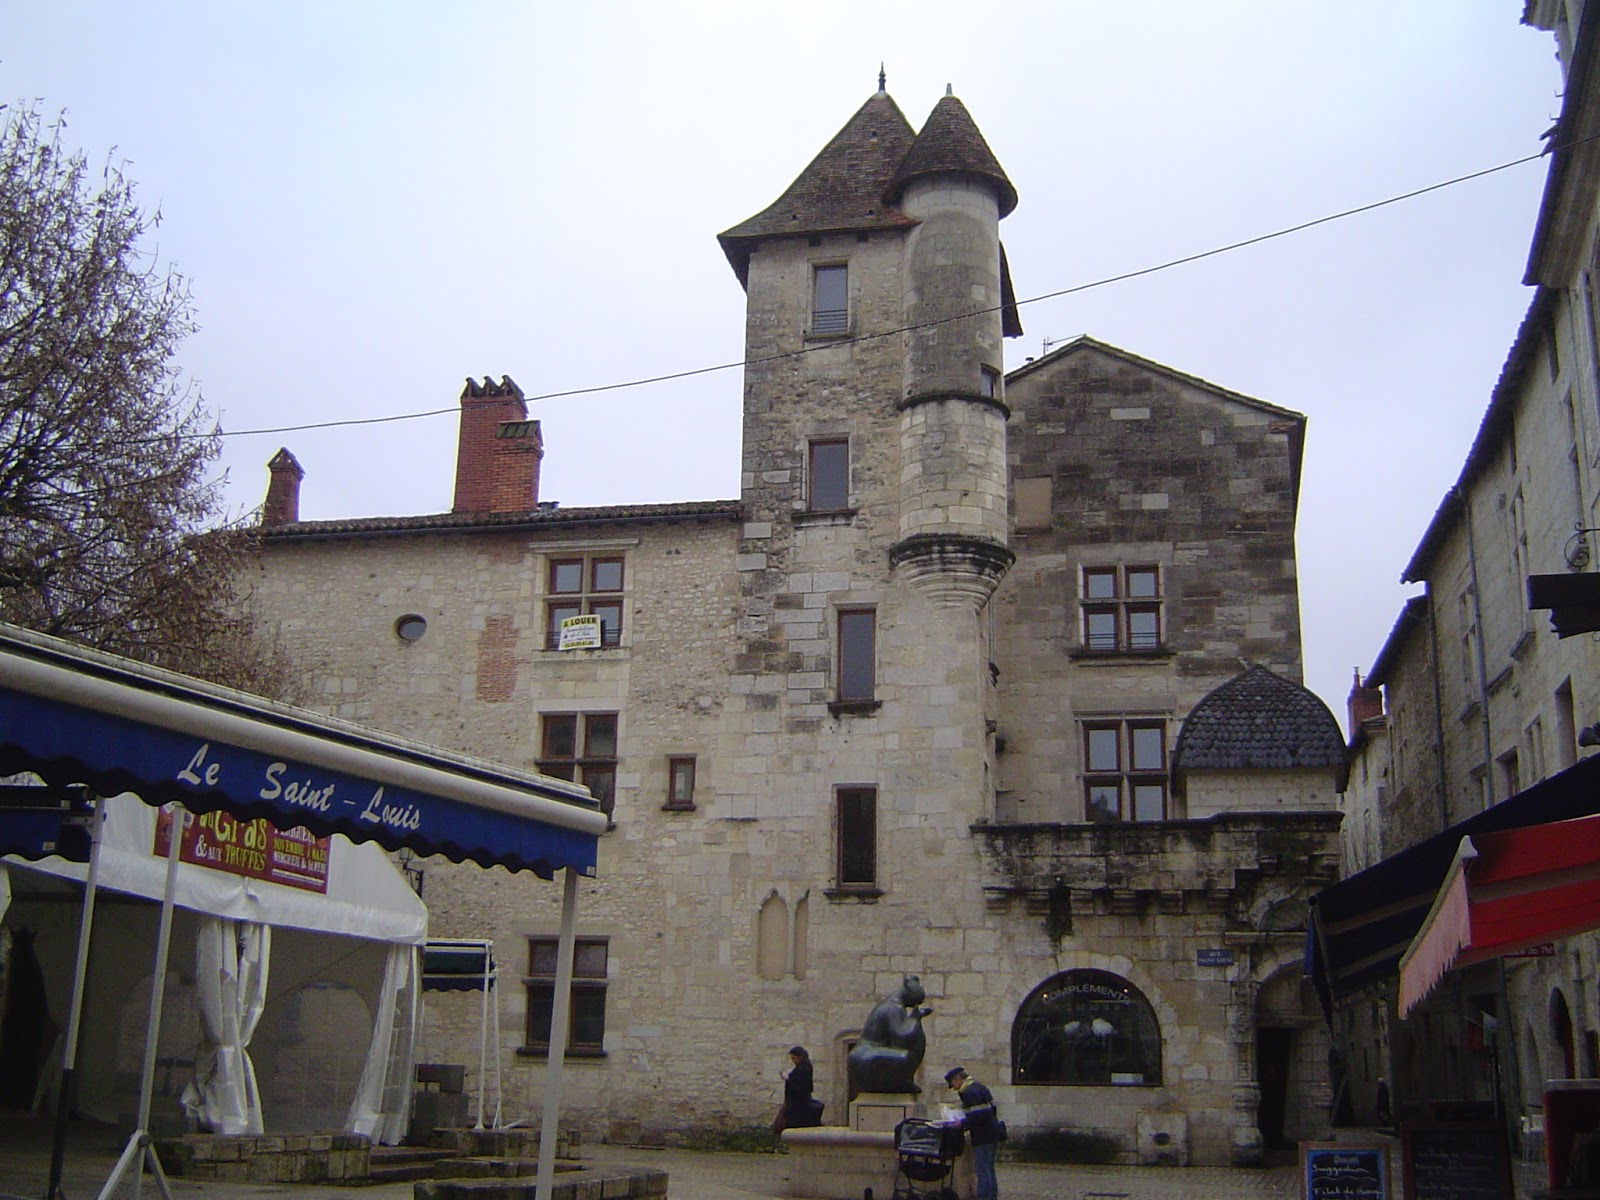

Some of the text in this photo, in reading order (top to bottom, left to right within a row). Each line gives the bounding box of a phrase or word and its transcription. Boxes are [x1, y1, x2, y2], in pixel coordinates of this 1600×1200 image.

[571, 617, 597, 626] LOUER
[177, 743, 220, 786] Le
[260, 762, 335, 812] Saint
[360, 786, 420, 830] Louis
[195, 834, 267, 871] & AUX TRUFFES
